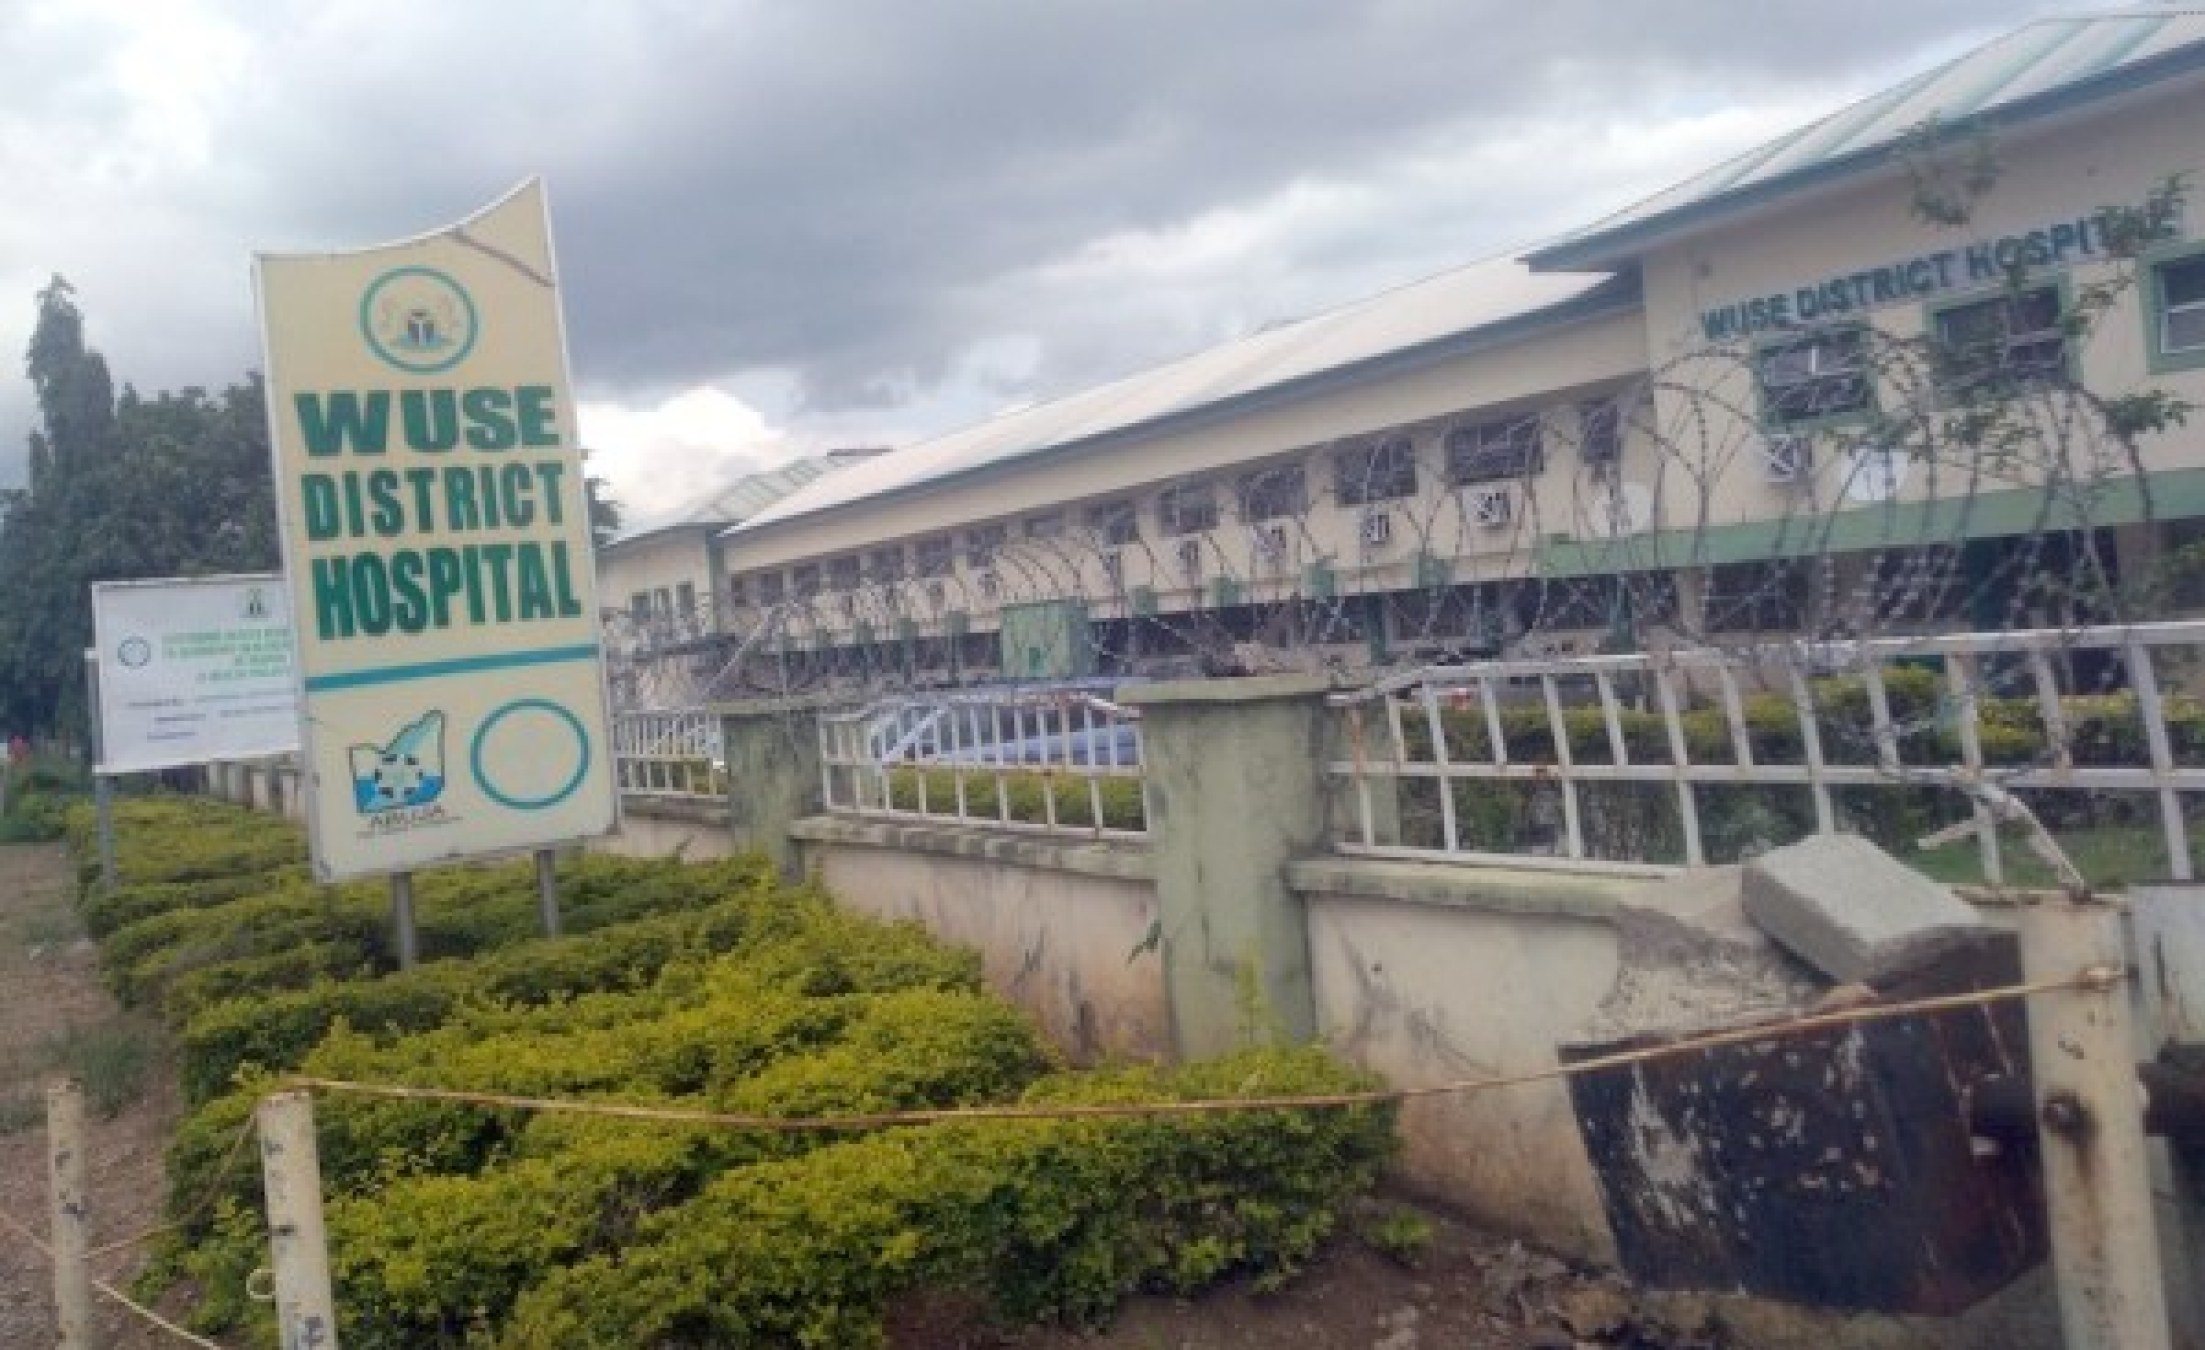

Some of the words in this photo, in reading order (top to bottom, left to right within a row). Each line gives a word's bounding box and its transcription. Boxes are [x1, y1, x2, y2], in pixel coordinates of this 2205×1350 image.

[1701, 294, 1791, 340] WUSE
[1796, 253, 1954, 320] DISTRICT
[1965, 202, 2166, 280] HOSPIT
[294, 386, 560, 457] WUSE
[300, 461, 564, 541] DISTRICT
[310, 540, 582, 640] HOSPITAL
